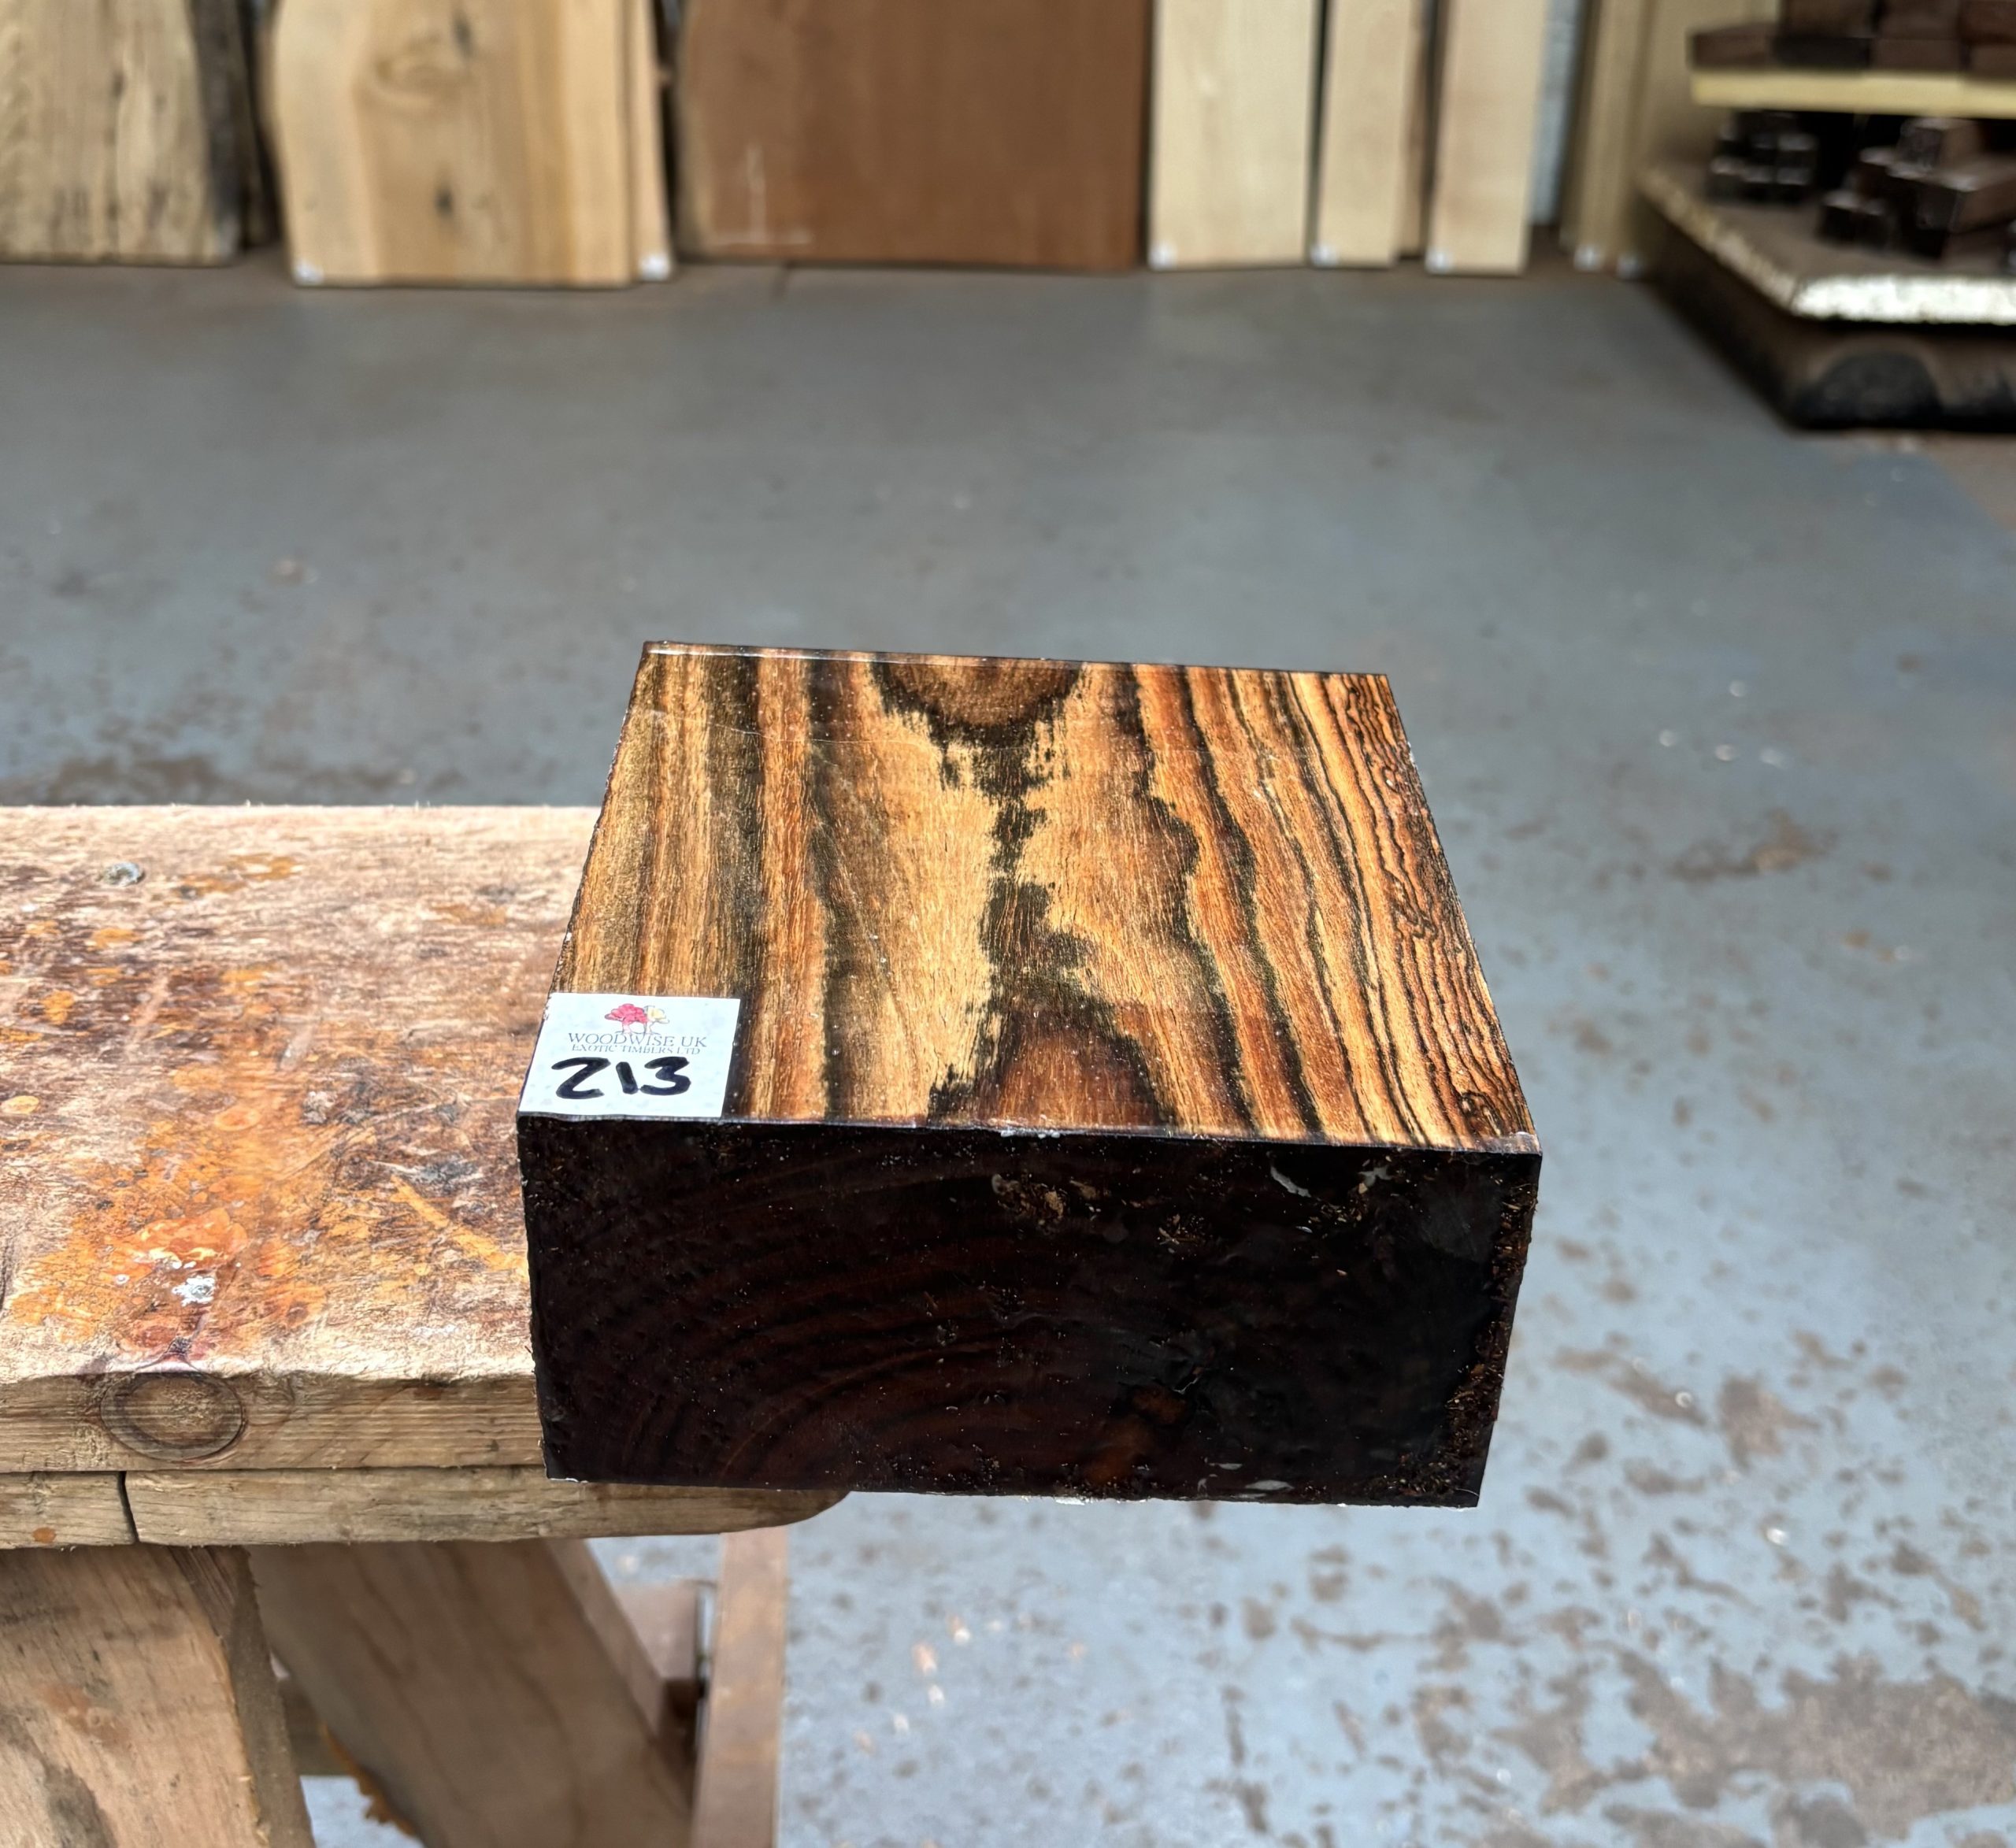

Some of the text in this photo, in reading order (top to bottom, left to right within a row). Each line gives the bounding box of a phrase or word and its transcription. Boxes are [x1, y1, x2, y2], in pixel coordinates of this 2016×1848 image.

[568, 1033, 708, 1048] WOODWISE UK
[551, 1056, 691, 1100] 213
